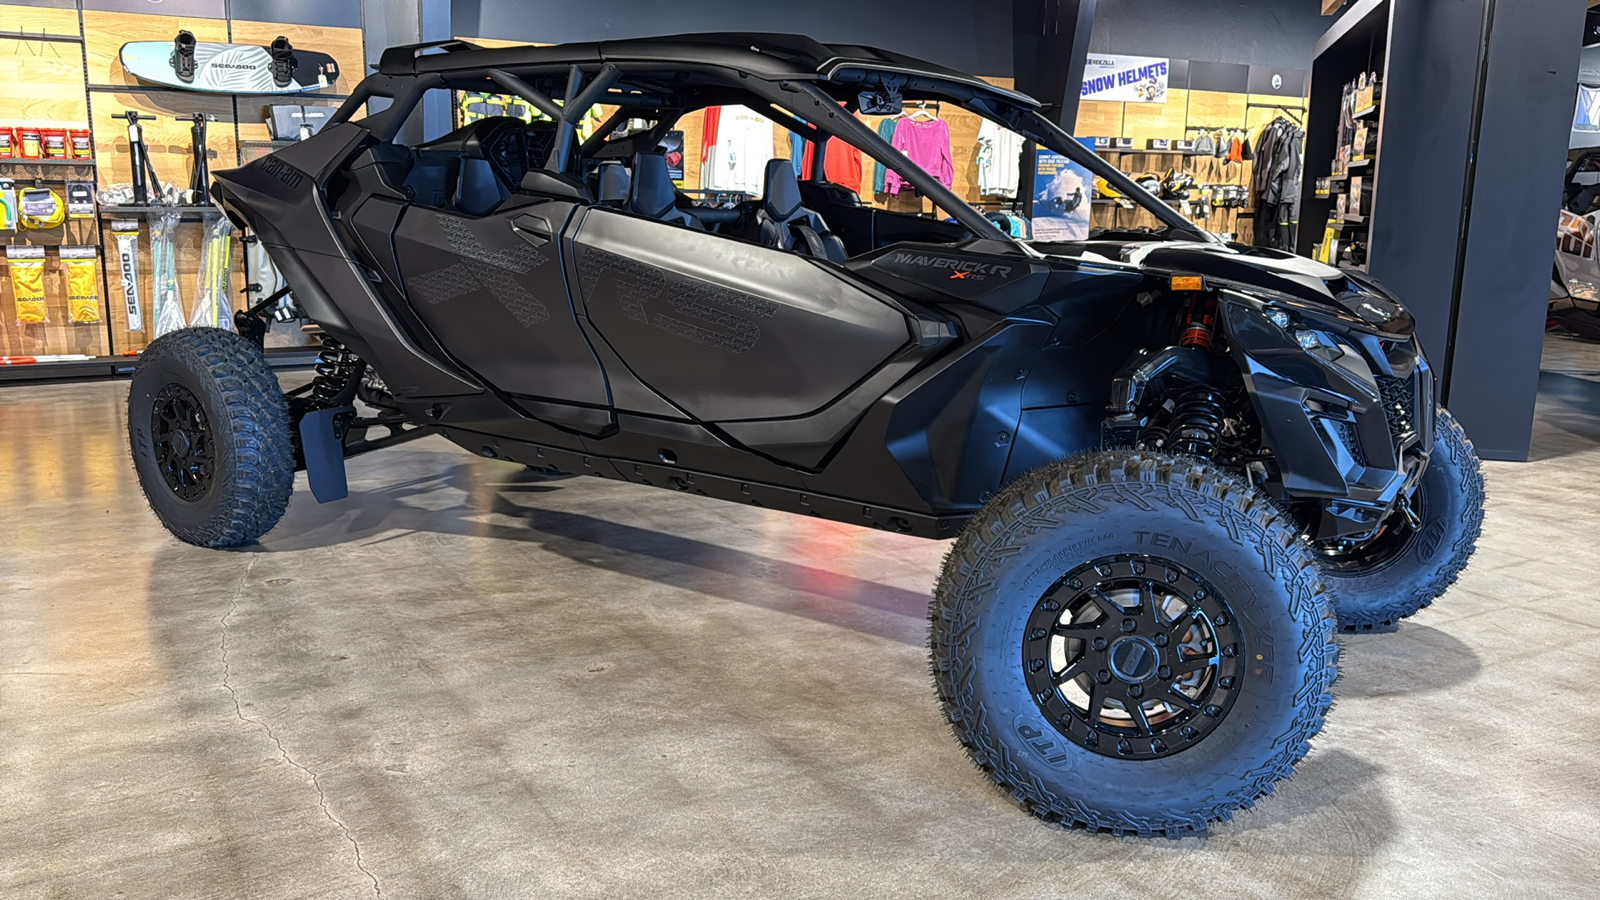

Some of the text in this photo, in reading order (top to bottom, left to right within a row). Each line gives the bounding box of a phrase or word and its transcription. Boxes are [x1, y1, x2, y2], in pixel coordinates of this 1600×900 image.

[1080, 61, 1167, 96] SNOW HELMETS
[894, 252, 1012, 279] MAVERICK R
[136, 427, 149, 458] ITP
[1423, 519, 1447, 561] ITP
[1132, 530, 1268, 612] TENACITY
[1017, 724, 1068, 764] ITP
